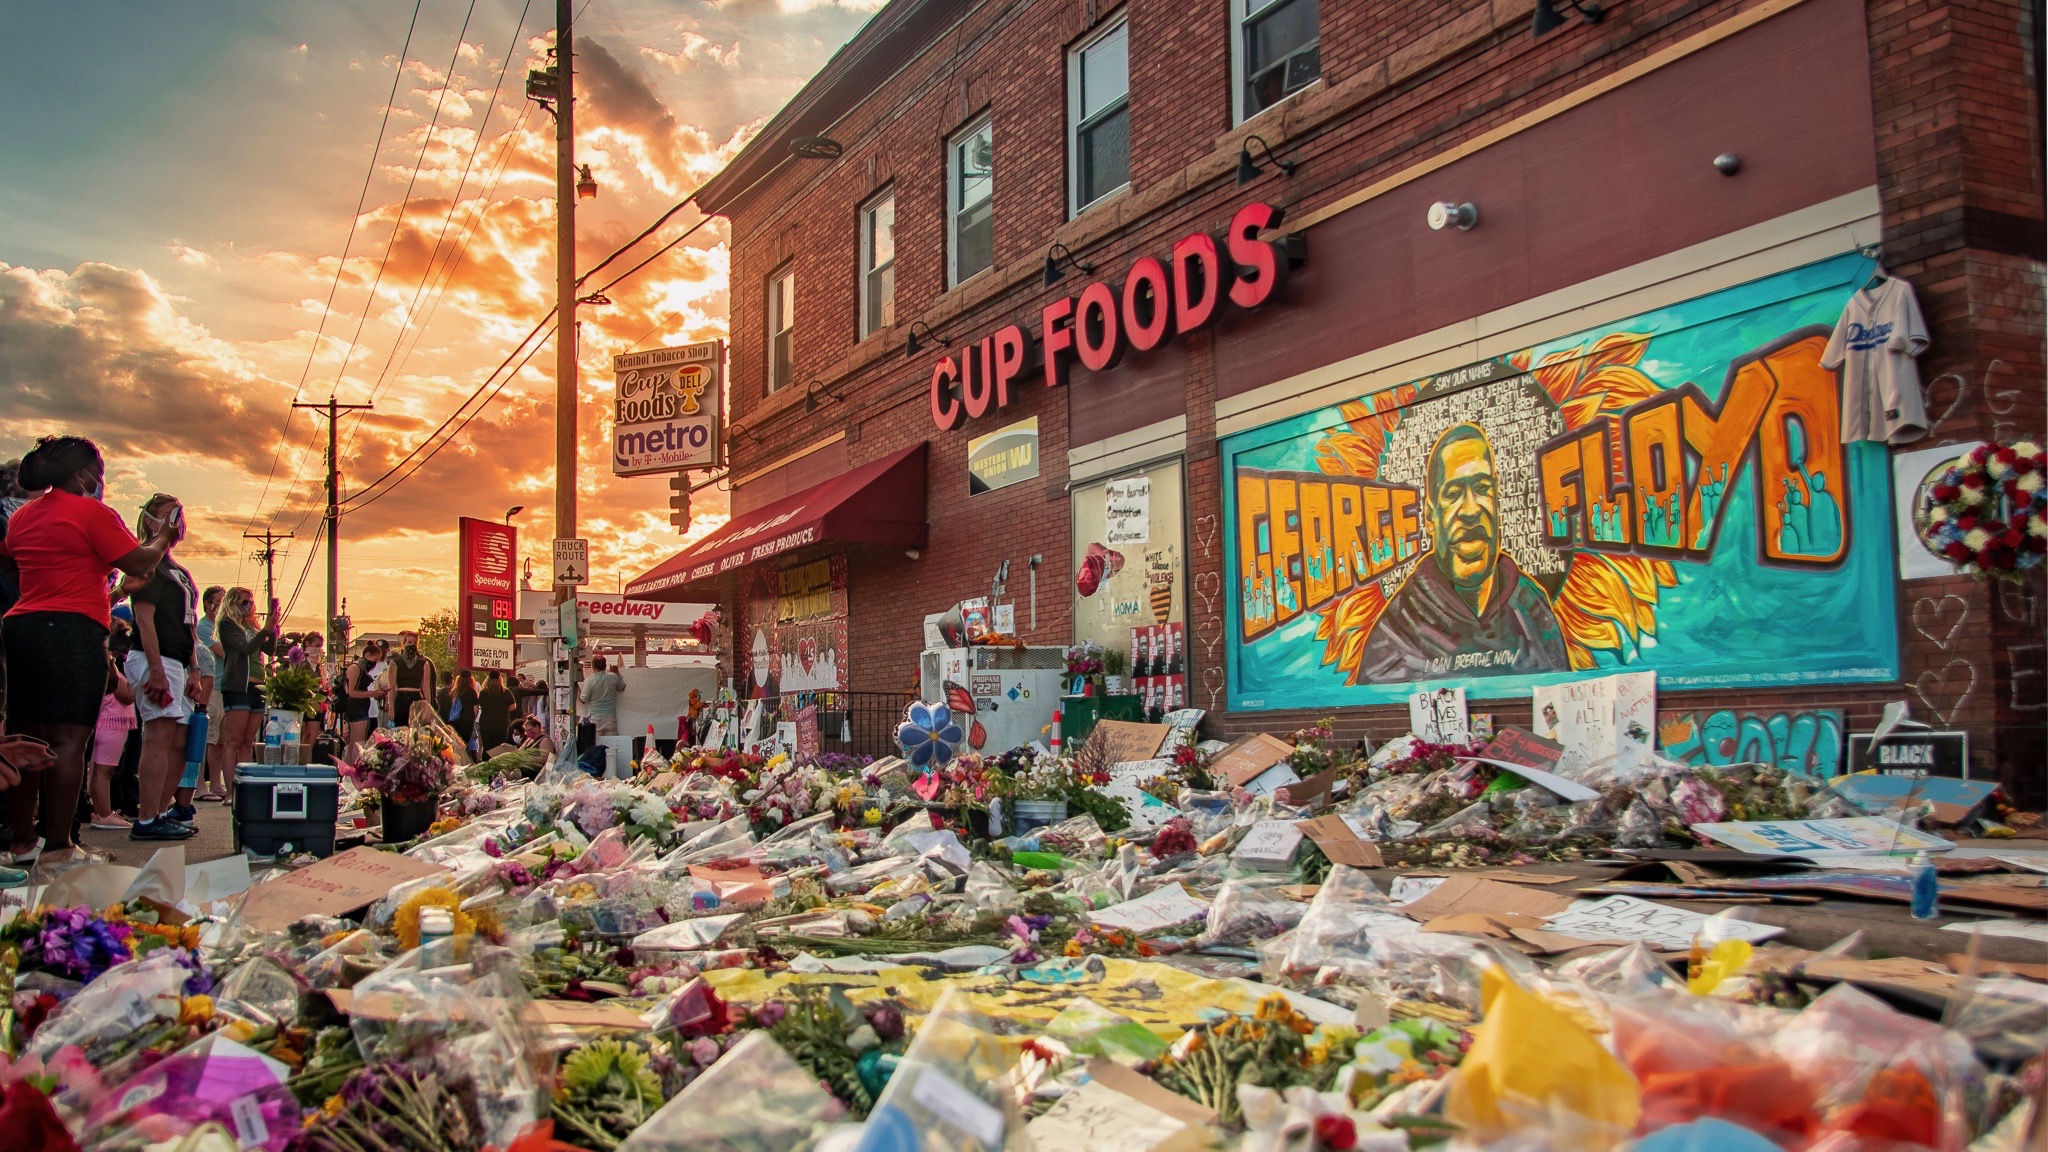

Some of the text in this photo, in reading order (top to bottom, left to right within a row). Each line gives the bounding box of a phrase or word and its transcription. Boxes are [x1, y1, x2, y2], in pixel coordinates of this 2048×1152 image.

[930, 203, 1276, 430] CUP FOODS
[617, 346, 708, 369] Menthol Tobacco Shop
[621, 370, 670, 399] Cup
[680, 374, 700, 389] DELI
[1435, 362, 1492, 392] SAY OUR NAMES
[1412, 397, 1448, 416] TERRENCE
[1449, 386, 1484, 405] CRUTCHER
[1487, 378, 1518, 395] JEREMY
[616, 394, 674, 422] Foods
[1404, 388, 1525, 429] TAMIR RICE PHILANDO CASTILE
[1482, 403, 1514, 418] FREDDIE
[1515, 396, 1535, 411] GREY
[1510, 406, 1544, 422] FRANKLIN
[1518, 415, 1546, 432] TAYLOR
[618, 422, 708, 455] metro
[1490, 432, 1524, 450] SHANTEL
[1524, 426, 1547, 442] DAVIS
[974, 443, 1032, 471] WESTERN WU
[1496, 442, 1524, 458] ALTER
[632, 457, 642, 469] by
[984, 462, 1008, 479] UNION
[1238, 333, 1847, 638] GEORGE FLOYD
[1498, 480, 1526, 498] SHELLY
[1498, 496, 1526, 512] TAMAR
[1498, 508, 1533, 525] TANISHA
[1499, 522, 1529, 537] TARIKA
[556, 542, 584, 550] TRUCK
[1501, 532, 1542, 550] ALTON STE
[556, 552, 584, 560] ROUTE
[646, 578, 670, 592] EASTERN
[671, 572, 686, 584] FOOD
[692, 562, 714, 579] CHEESE
[720, 552, 745, 571] OLIVES
[750, 541, 775, 560] FRESH
[775, 528, 814, 552] PRODUCE
[1145, 551, 1162, 562] WHITE
[1510, 546, 1560, 566] KORRYNGA
[1522, 560, 1564, 576] KATHRYN
[474, 574, 510, 589] Speedway
[1150, 572, 1173, 584] VIOLENCE
[577, 600, 664, 620] peedway
[474, 648, 508, 659] GEORGE FLOYD
[1424, 648, 1520, 673] I CAN BREATHE NOW
[1011, 690, 1016, 698] 1
[1016, 682, 1022, 690] 4
[1562, 682, 1605, 703] JUSTICE
[1420, 688, 1456, 710] BLACK
[1586, 700, 1594, 710] 4
[1430, 706, 1456, 723] LIVES
[1425, 718, 1464, 735] MATTER
[1880, 744, 1934, 764] BLACK
[329, 851, 390, 876] Racism
[283, 868, 343, 892] Pandemic
[1580, 898, 1698, 934] BLACK
